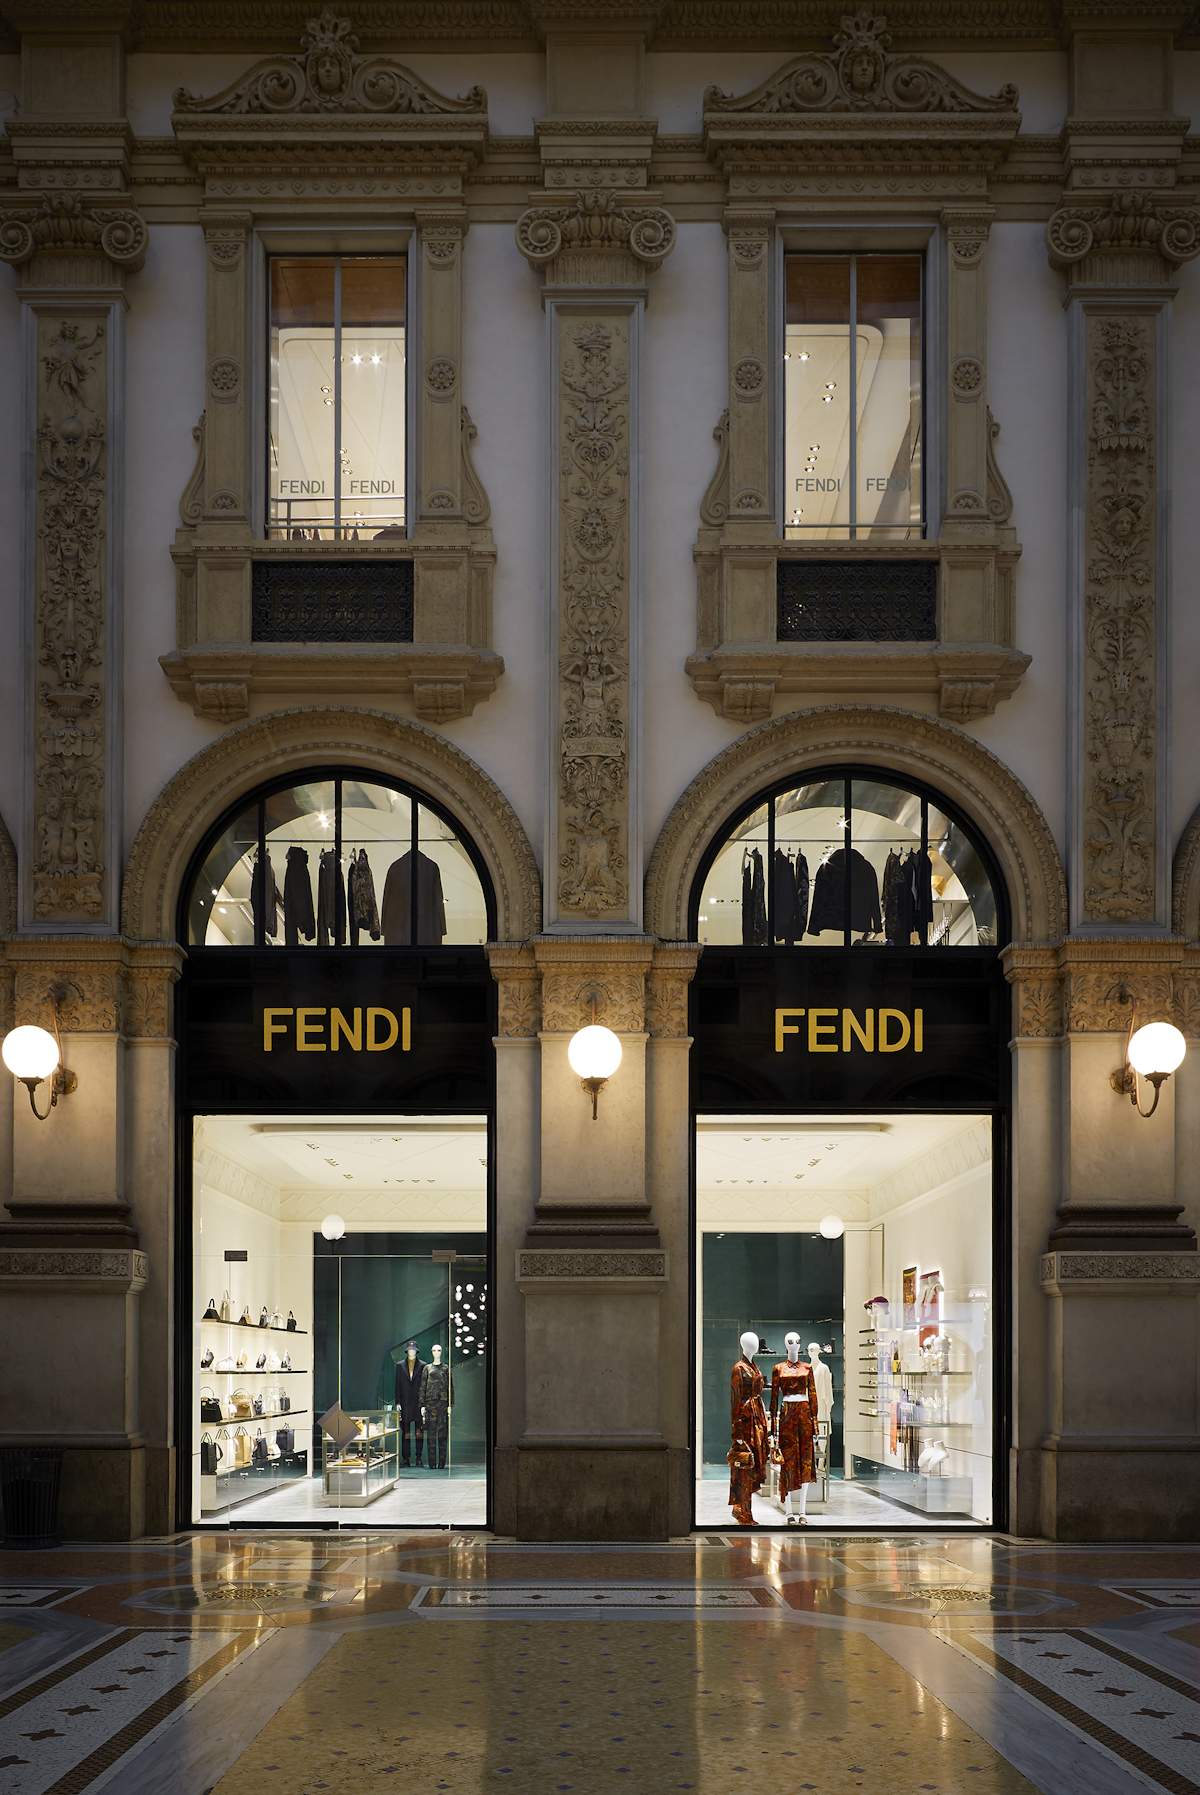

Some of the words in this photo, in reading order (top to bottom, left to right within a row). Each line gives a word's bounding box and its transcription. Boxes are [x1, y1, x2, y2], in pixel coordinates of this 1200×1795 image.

[280, 480, 325, 494] FENDI
[350, 480, 395, 494] FENDI
[795, 478, 840, 492] FENDI
[263, 1007, 411, 1052] FENDI
[775, 1008, 924, 1053] FENDI
